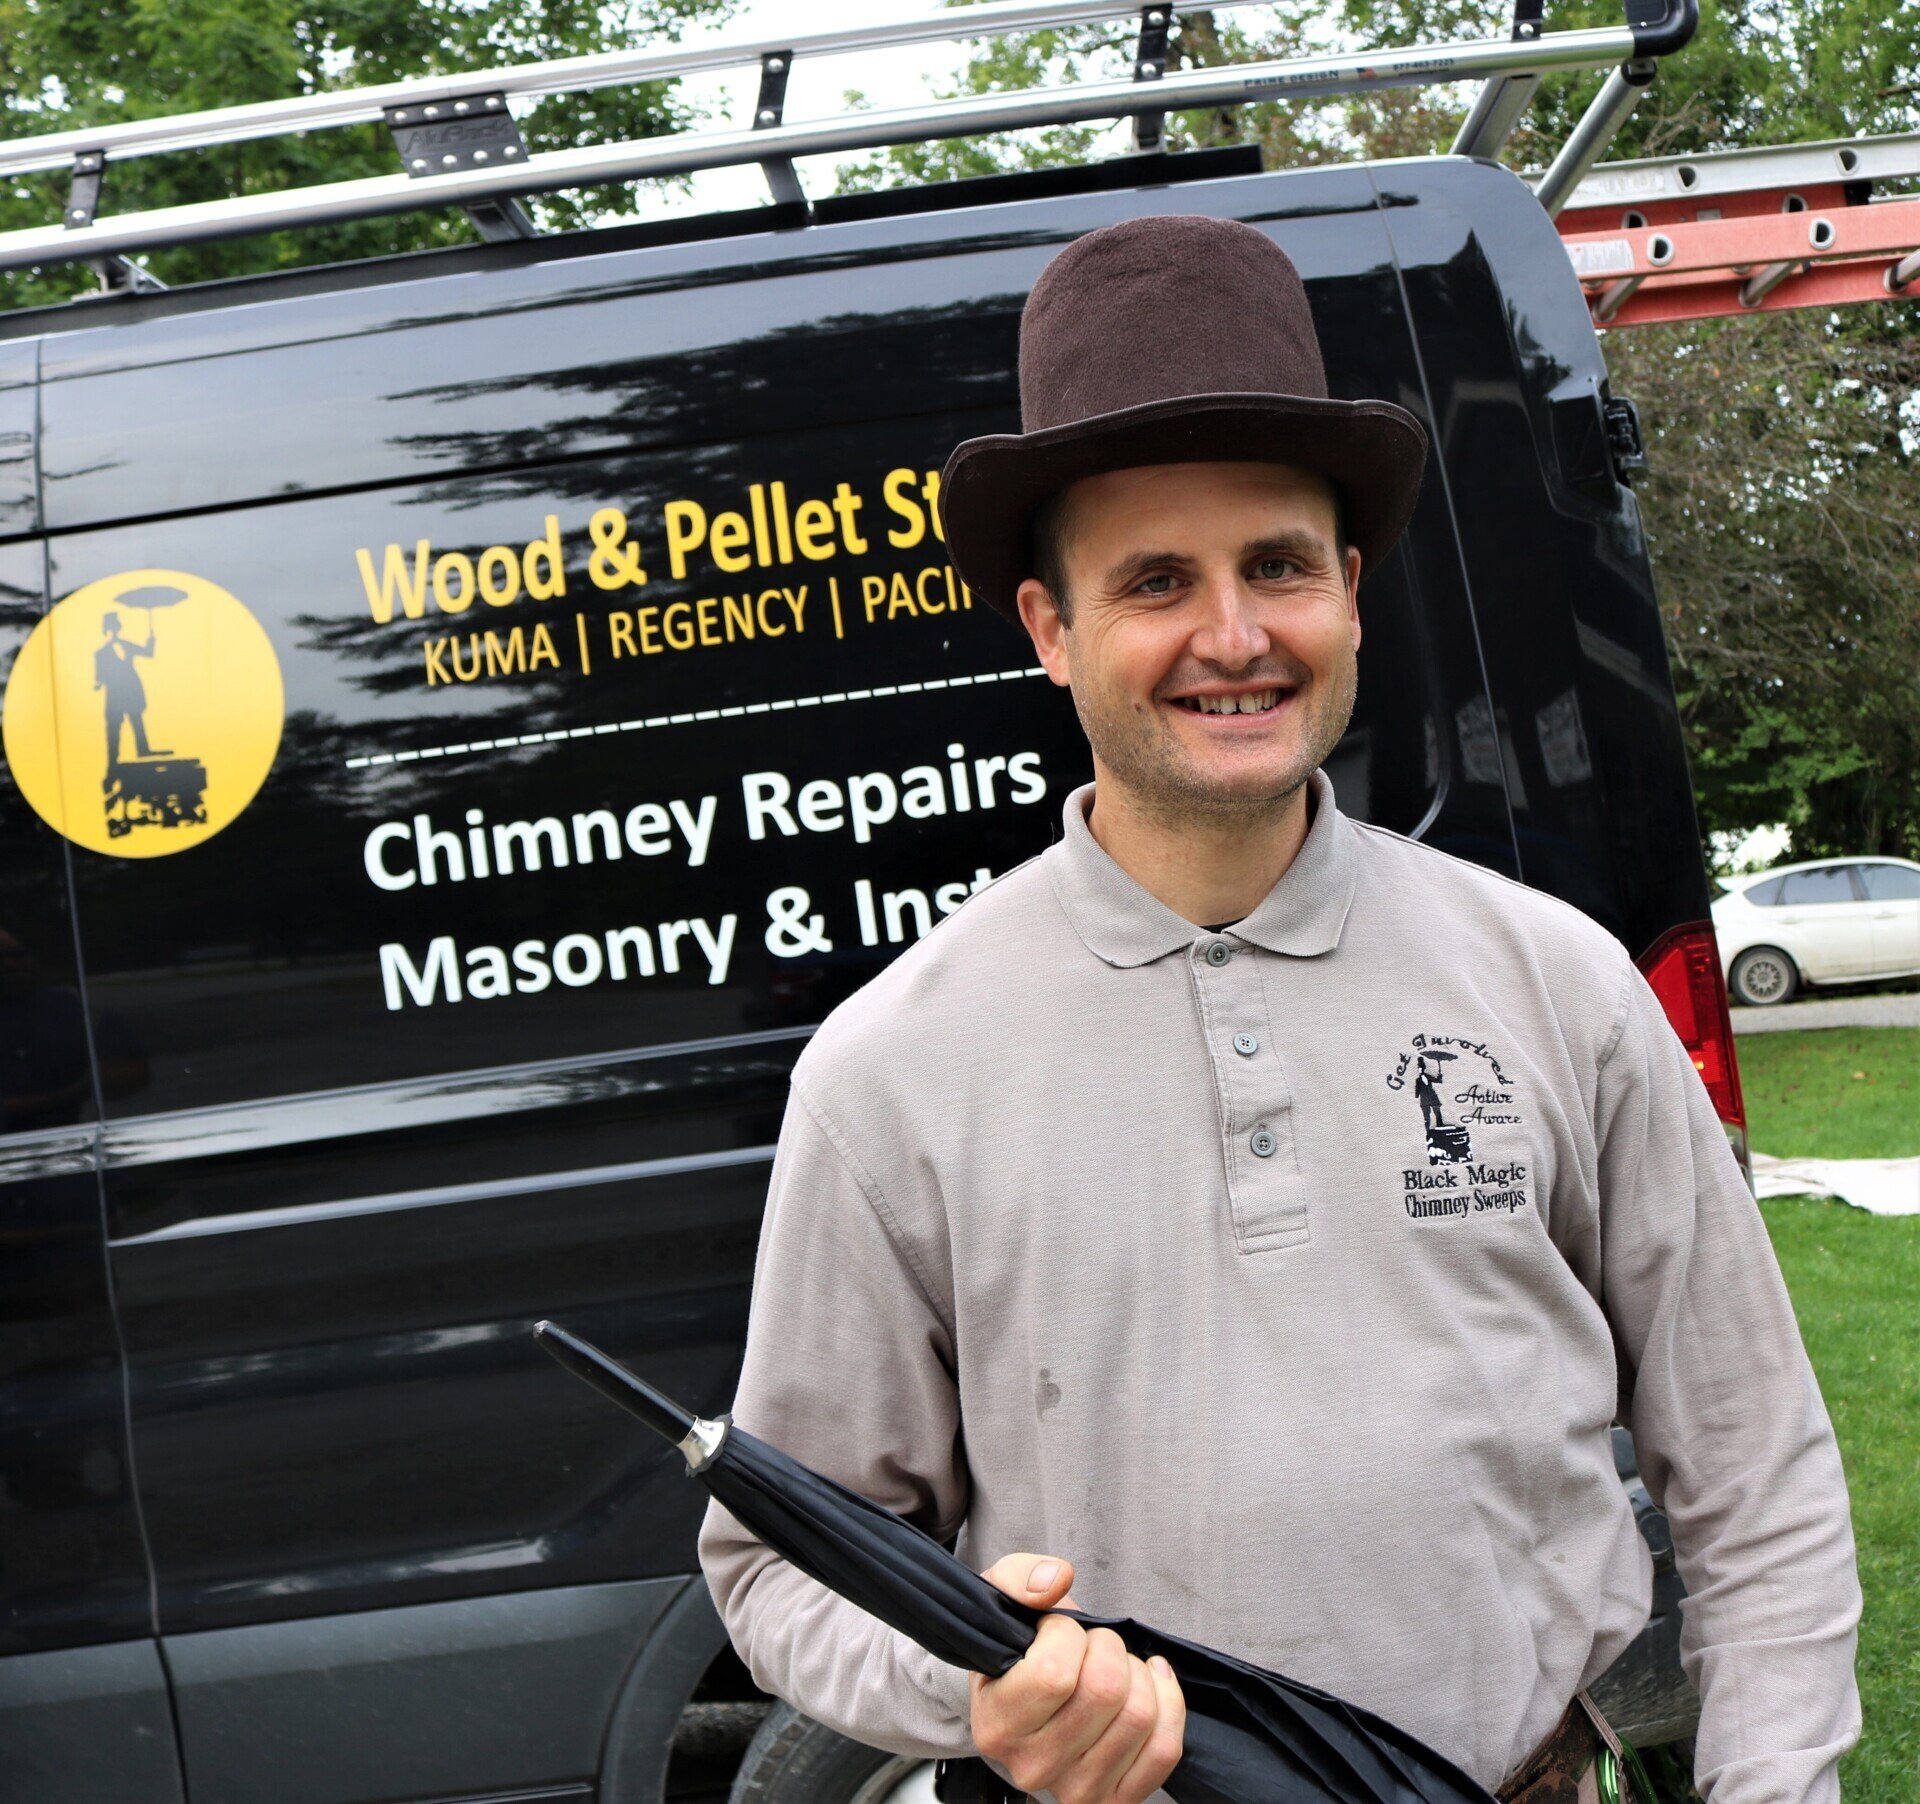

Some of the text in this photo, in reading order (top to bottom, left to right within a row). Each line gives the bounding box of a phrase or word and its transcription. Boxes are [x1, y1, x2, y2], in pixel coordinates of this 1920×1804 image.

[1244, 70, 1340, 87] PRIME DESIGN
[357, 515, 566, 624] Wood
[588, 508, 647, 591] &
[664, 481, 868, 580] Pellet
[424, 623, 560, 685] KUMA
[608, 585, 808, 659] REGENCY
[363, 743, 1047, 891] Chimney Repairs
[379, 914, 737, 1011] Masonry
[764, 886, 833, 958] &
[1386, 1033, 1515, 1091] Get Involved
[1454, 1084, 1514, 1105] Active
[1459, 1107, 1523, 1126] Aware
[1402, 1162, 1527, 1190] Black Magic
[1404, 1188, 1527, 1219] Chimney Sweeps
